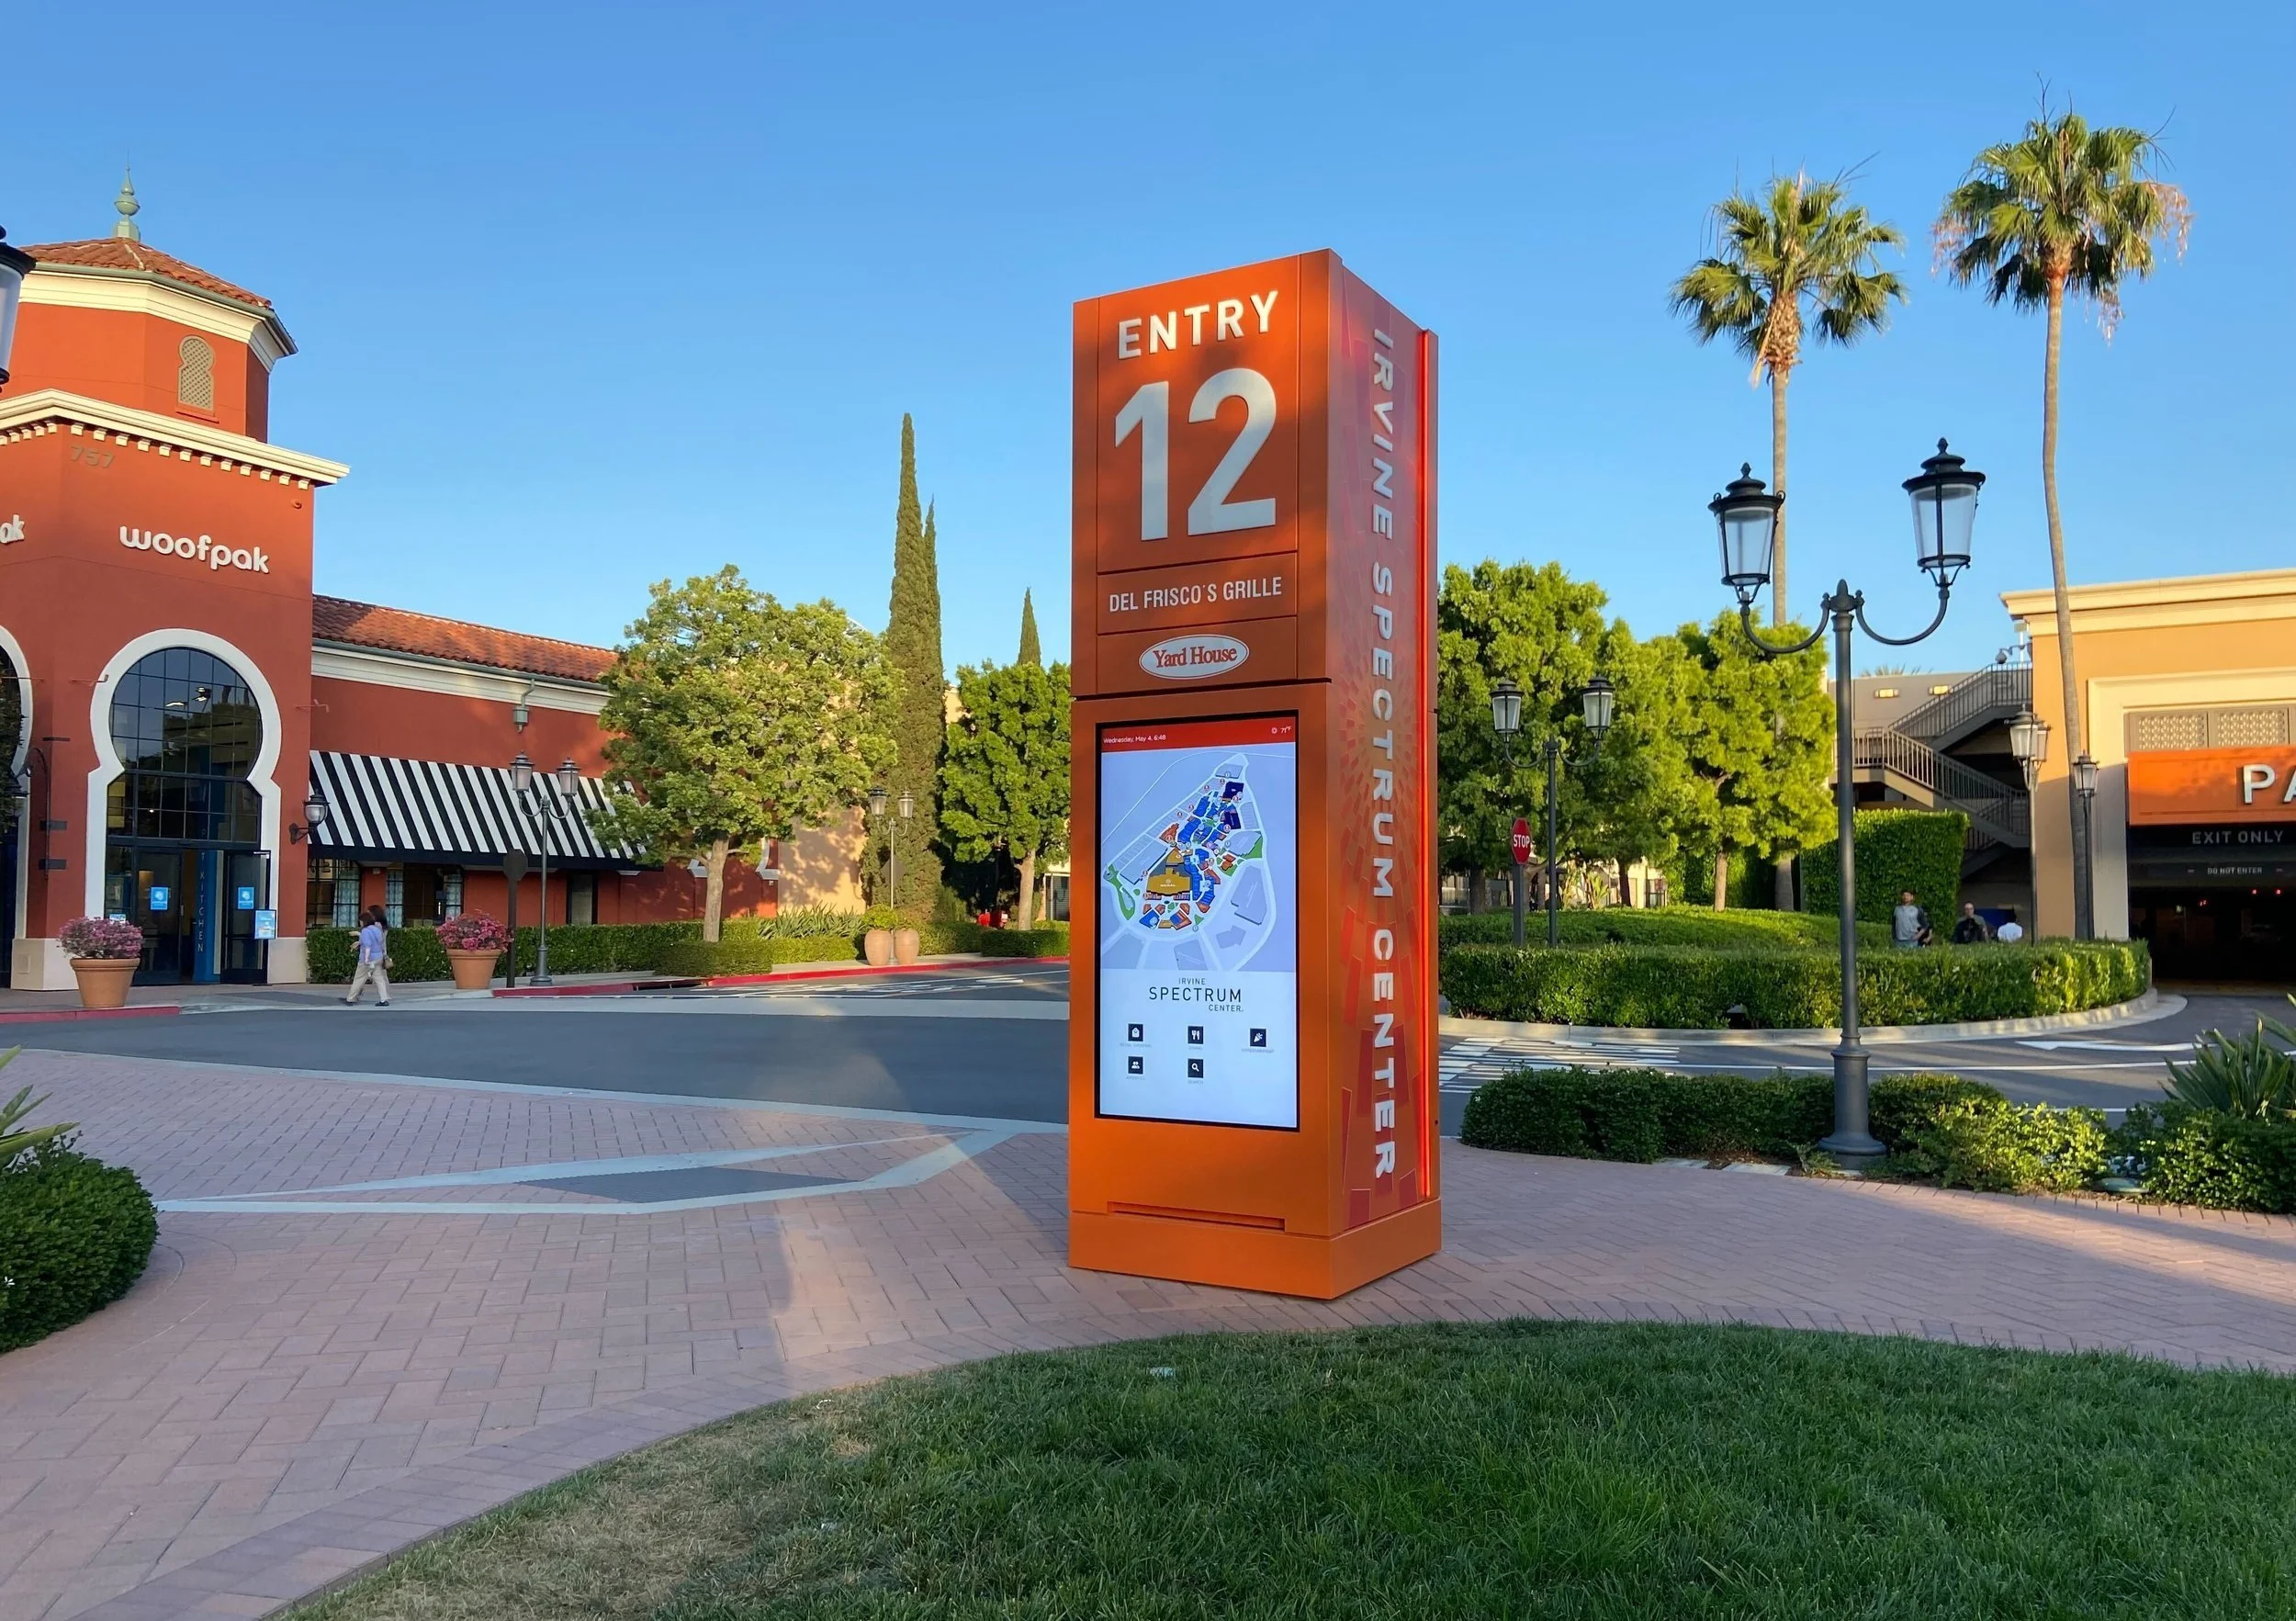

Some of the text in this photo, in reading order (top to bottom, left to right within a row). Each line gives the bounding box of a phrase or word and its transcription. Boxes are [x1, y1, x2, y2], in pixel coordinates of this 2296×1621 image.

[1118, 290, 1278, 359] ENTRY
[69, 445, 115, 468] 757
[1115, 367, 1277, 541] 12
[119, 525, 270, 573] woofpak
[1109, 576, 1282, 613] DEL FRISCO'S GRILLE
[1153, 646, 1238, 668] Yard House
[1372, 328, 1395, 1178] IRVINE SPECTRUM CENTER
[1513, 834, 1530, 849] STOP
[2192, 829, 2284, 844] EXIT ONLY
[2236, 866, 2263, 874] ENTER
[197, 872, 206, 952] KITCHEN
[1178, 977, 1206, 985] IRVINE
[1149, 986, 1242, 1003] SPECTRUM
